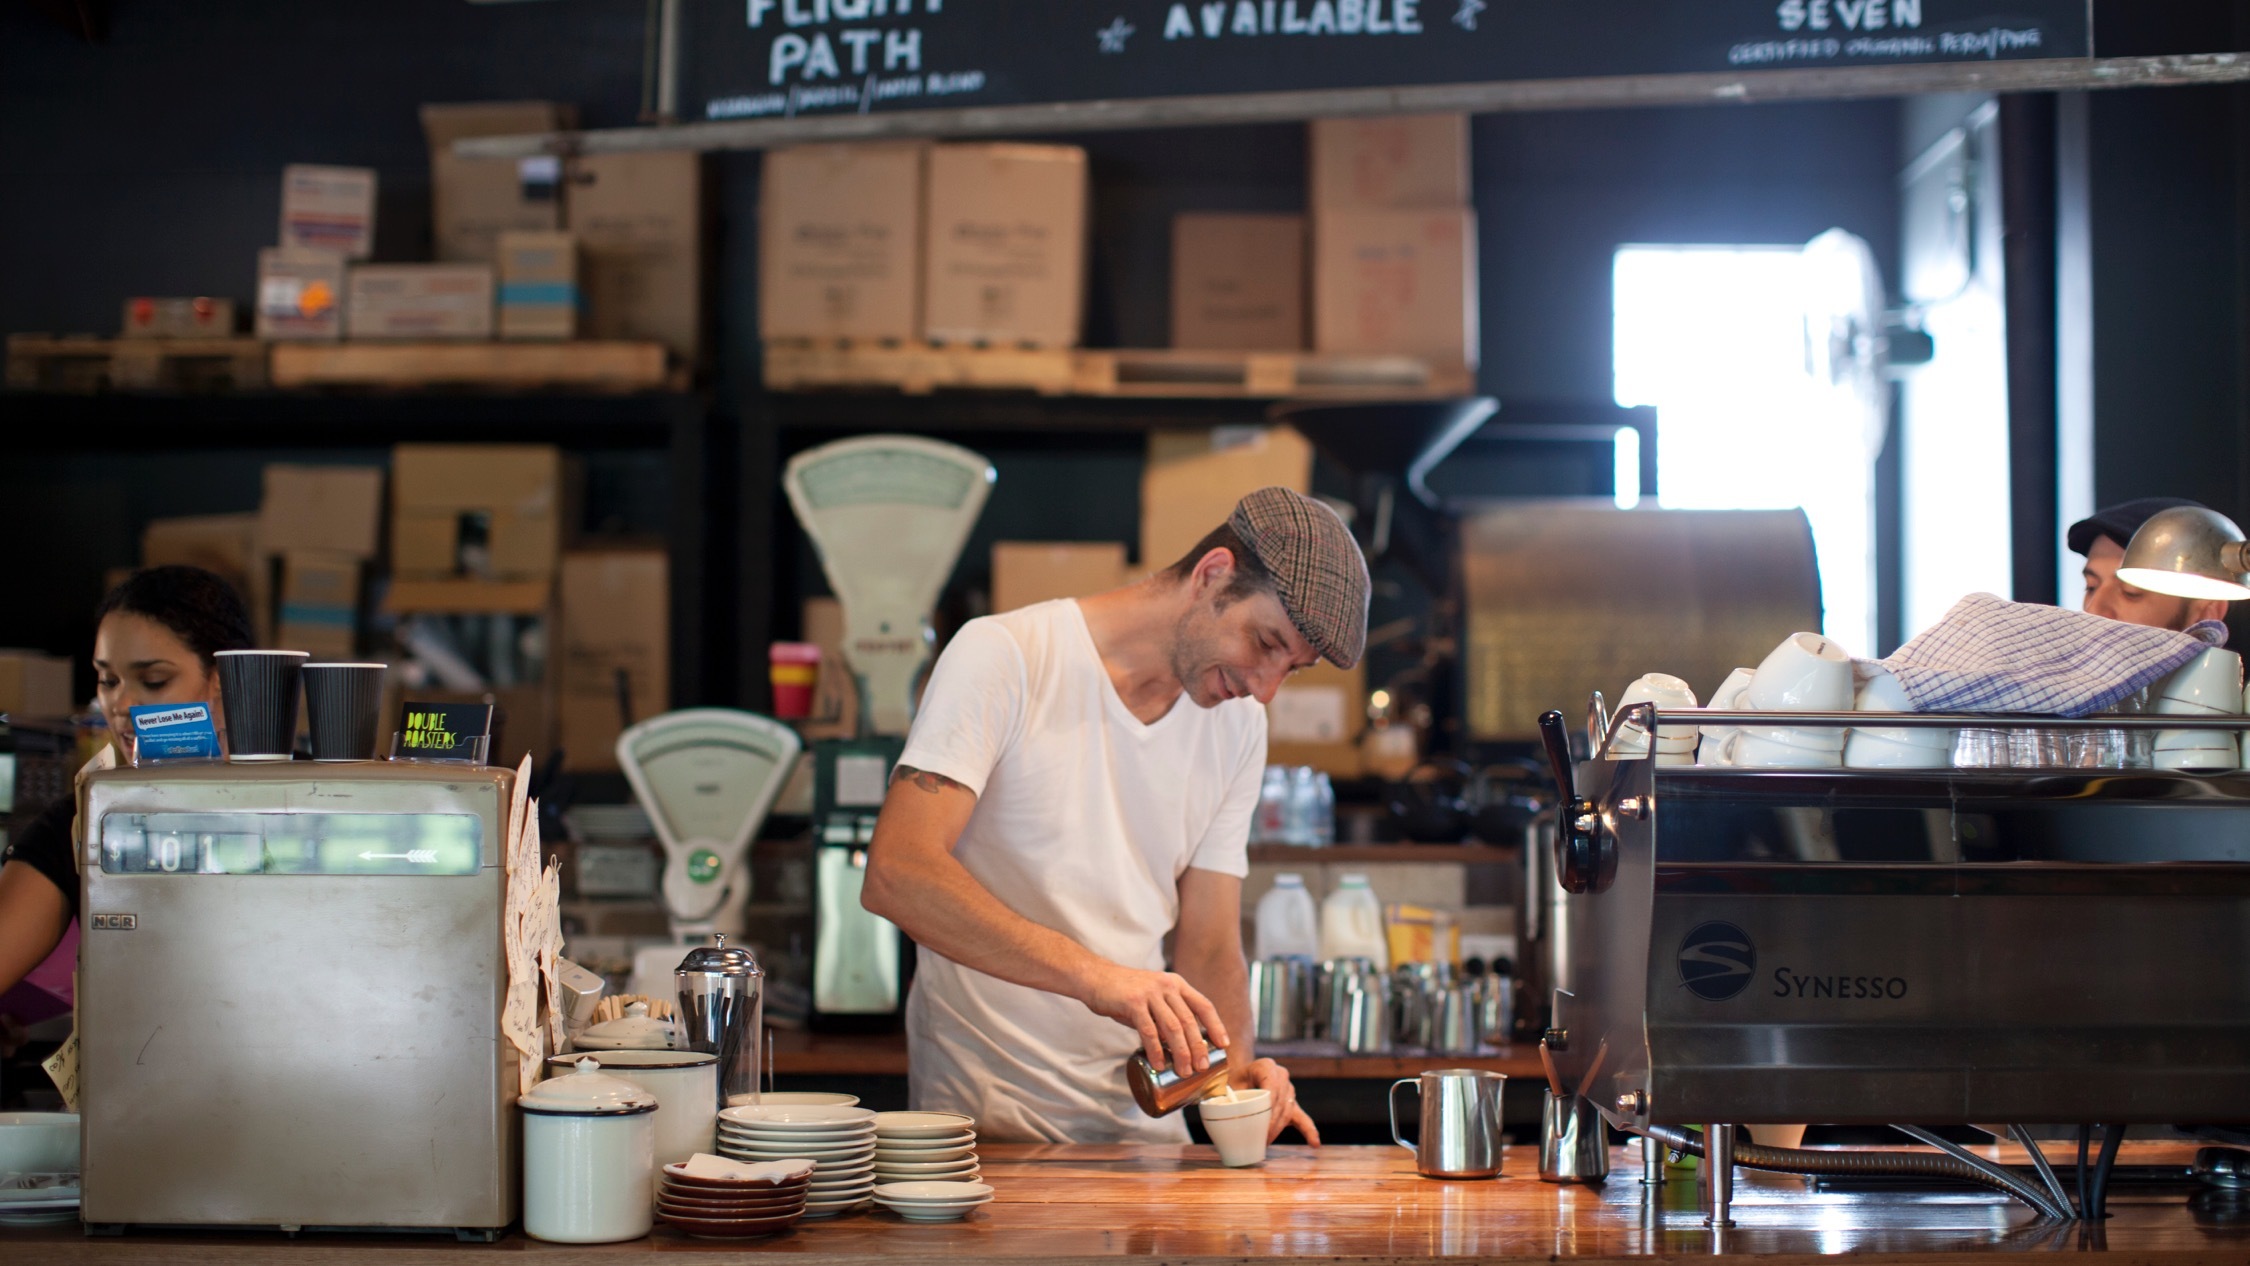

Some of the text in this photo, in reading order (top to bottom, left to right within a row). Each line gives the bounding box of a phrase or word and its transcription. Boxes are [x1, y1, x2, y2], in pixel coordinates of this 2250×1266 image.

[746, 0, 943, 28] FLI
[1163, 0, 1422, 39] AVAILABLE
[1777, 0, 1922, 30] SEVEN
[769, 28, 922, 85] PATH
[138, 709, 204, 726] Never Lose Me Again!
[408, 712, 447, 731] DOUBLE
[403, 730, 457, 749] ROASTERS
[93, 916, 134, 928] NCR
